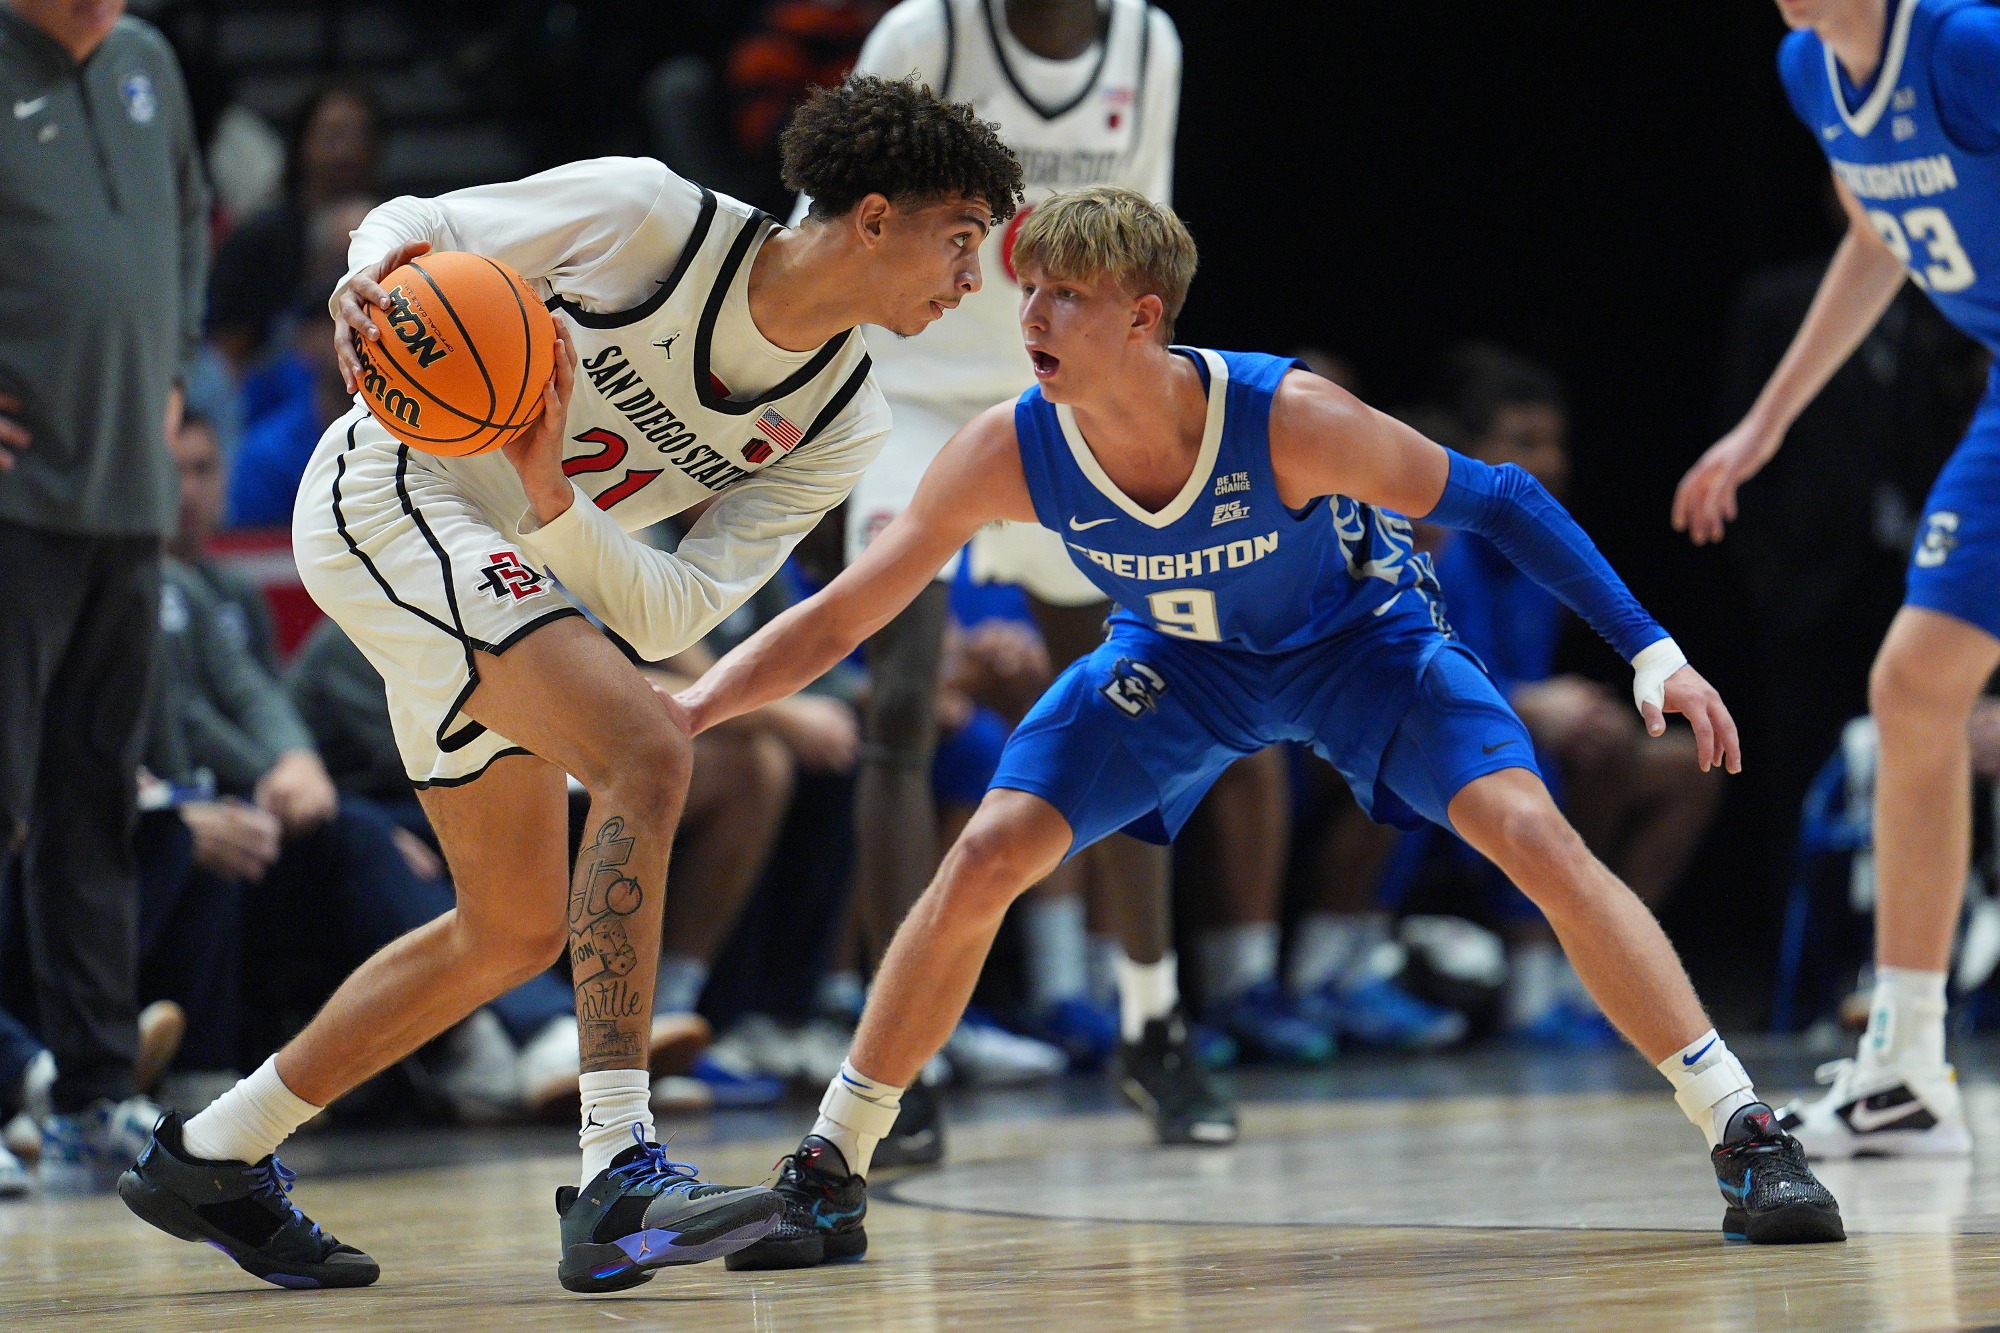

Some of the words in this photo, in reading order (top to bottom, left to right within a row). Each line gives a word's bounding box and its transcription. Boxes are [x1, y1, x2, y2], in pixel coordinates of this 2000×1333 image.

[385, 284, 448, 369] NCAA
[582, 345, 643, 401] SAN
[613, 387, 697, 455] DIEGO
[562, 426, 665, 511] 21
[1216, 474, 1230, 487] BE
[1231, 471, 1249, 483] THE
[1214, 480, 1251, 496] CHANGE
[1211, 506, 1251, 522] EAST
[1213, 500, 1241, 514] BIG
[1147, 587, 1222, 642] 9
